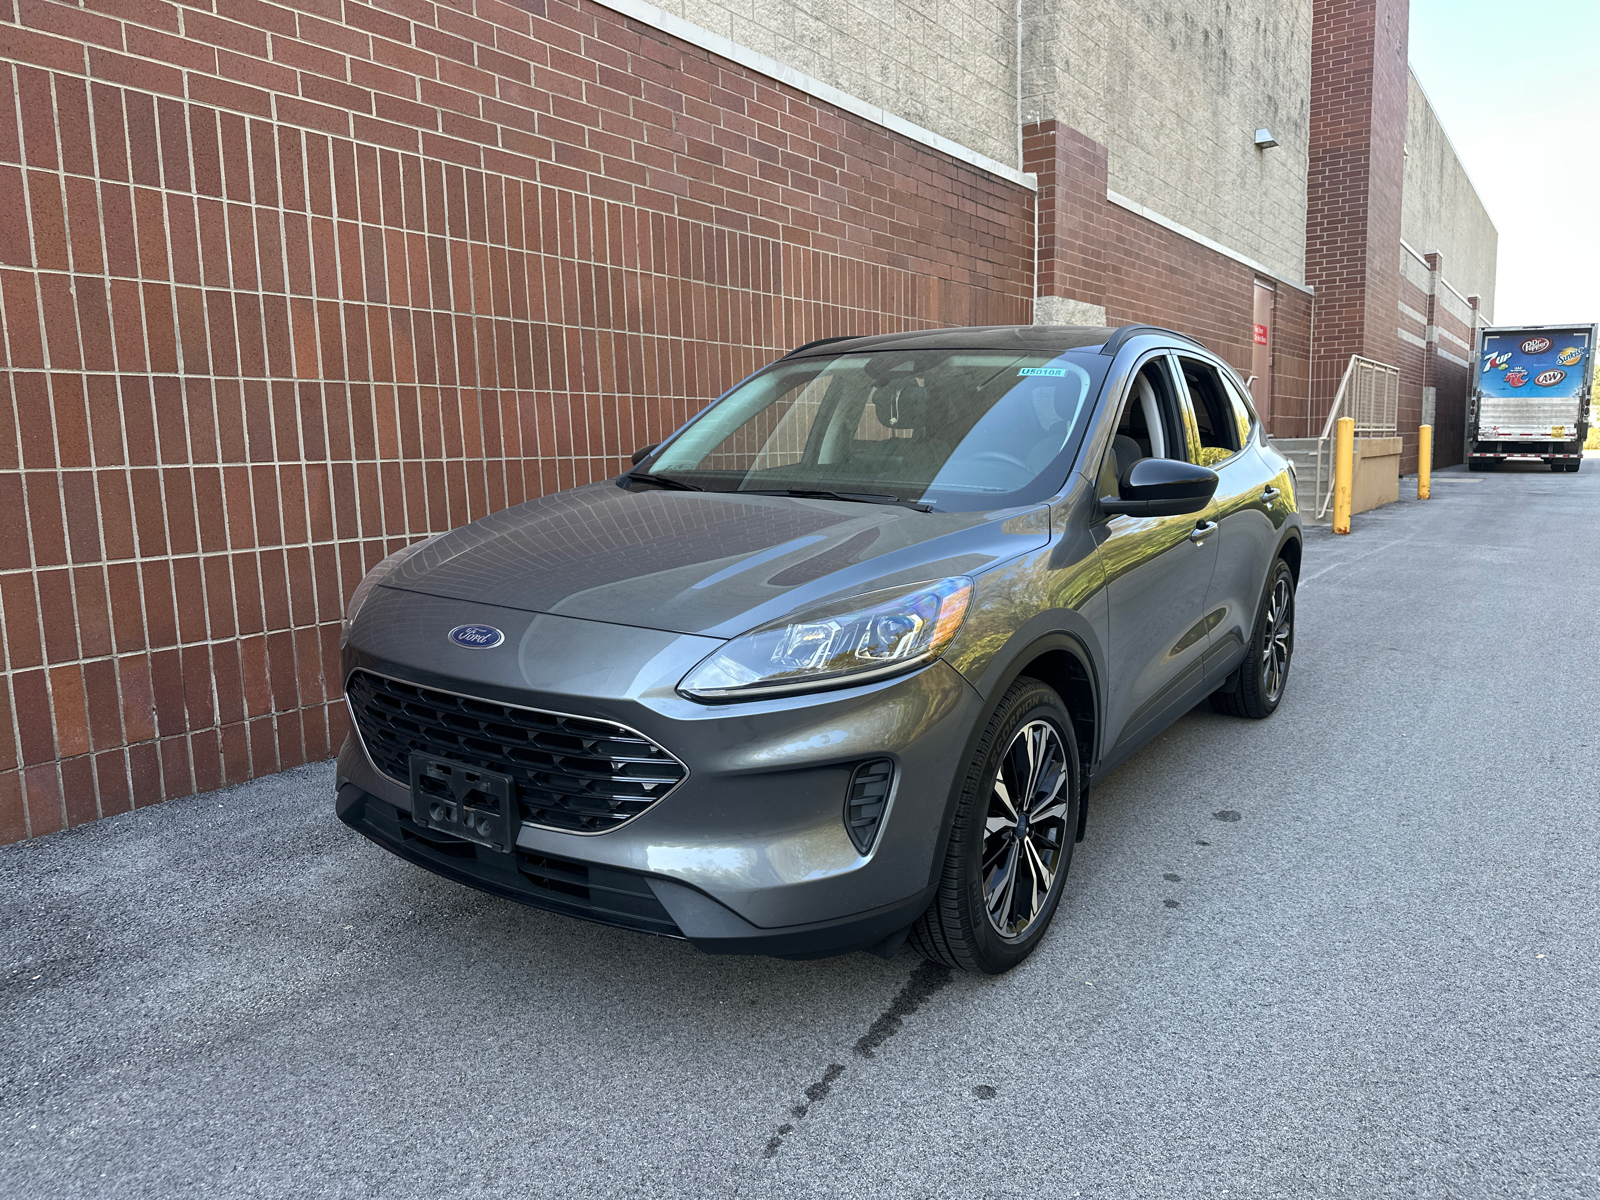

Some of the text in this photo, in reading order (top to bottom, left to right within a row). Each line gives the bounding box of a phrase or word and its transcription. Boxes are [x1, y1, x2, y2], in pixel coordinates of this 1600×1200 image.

[1525, 341, 1548, 352] Pepper
[1556, 347, 1585, 366] Sunkist
[1504, 371, 1529, 387] RC
[459, 628, 491, 643] Ford
[990, 694, 1055, 768] SCORPION AS
